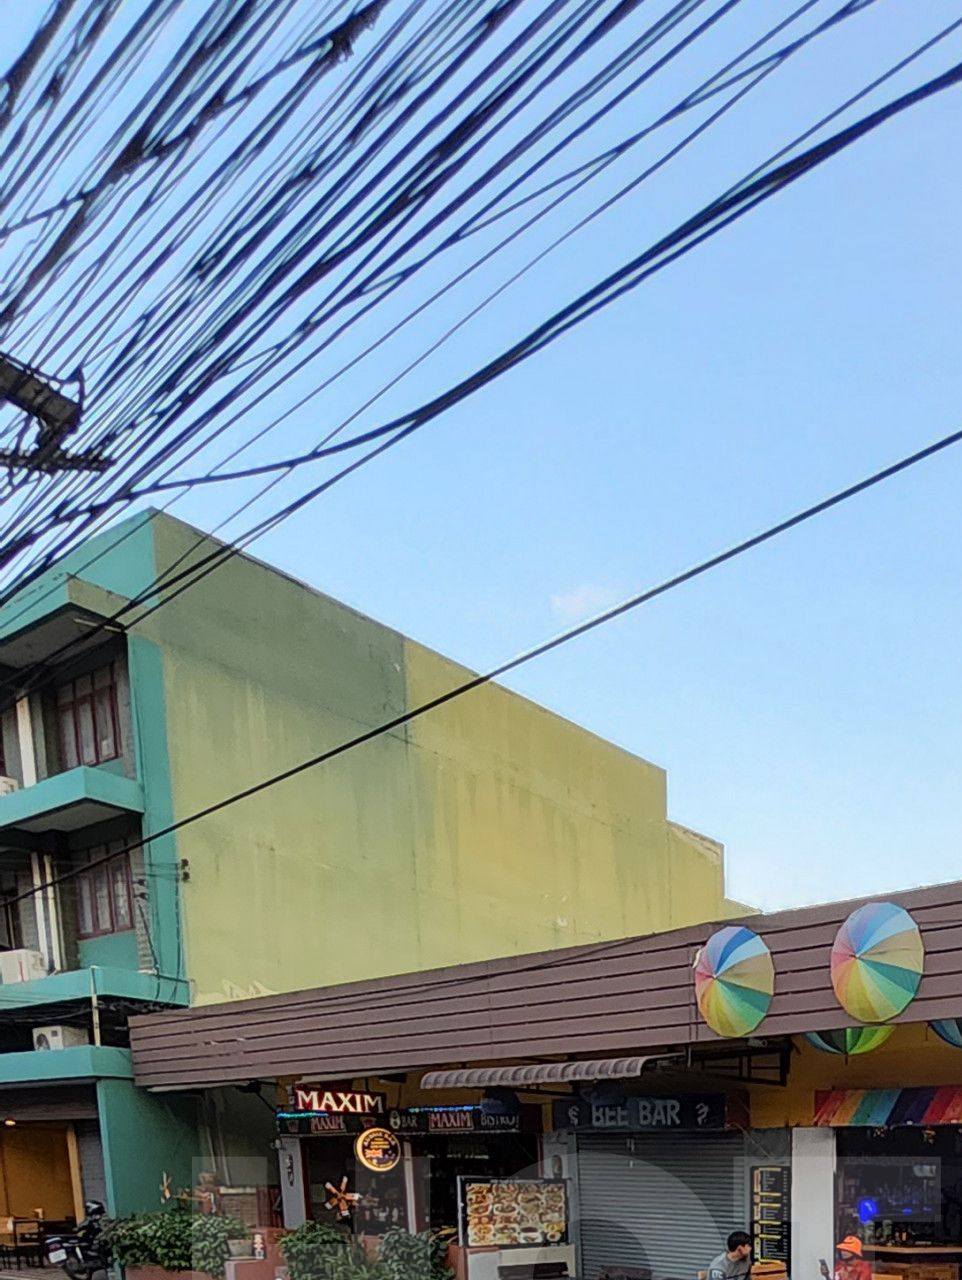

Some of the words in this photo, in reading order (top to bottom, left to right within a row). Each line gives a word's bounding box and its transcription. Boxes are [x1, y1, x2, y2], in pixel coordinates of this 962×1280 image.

[296, 1089, 383, 1114] MAXIM
[592, 1105, 630, 1127] BEE
[639, 1099, 681, 1126] BAR
[311, 1114, 344, 1130] MAXIM
[401, 1115, 418, 1128] BAR
[431, 1112, 472, 1128] MAXIM
